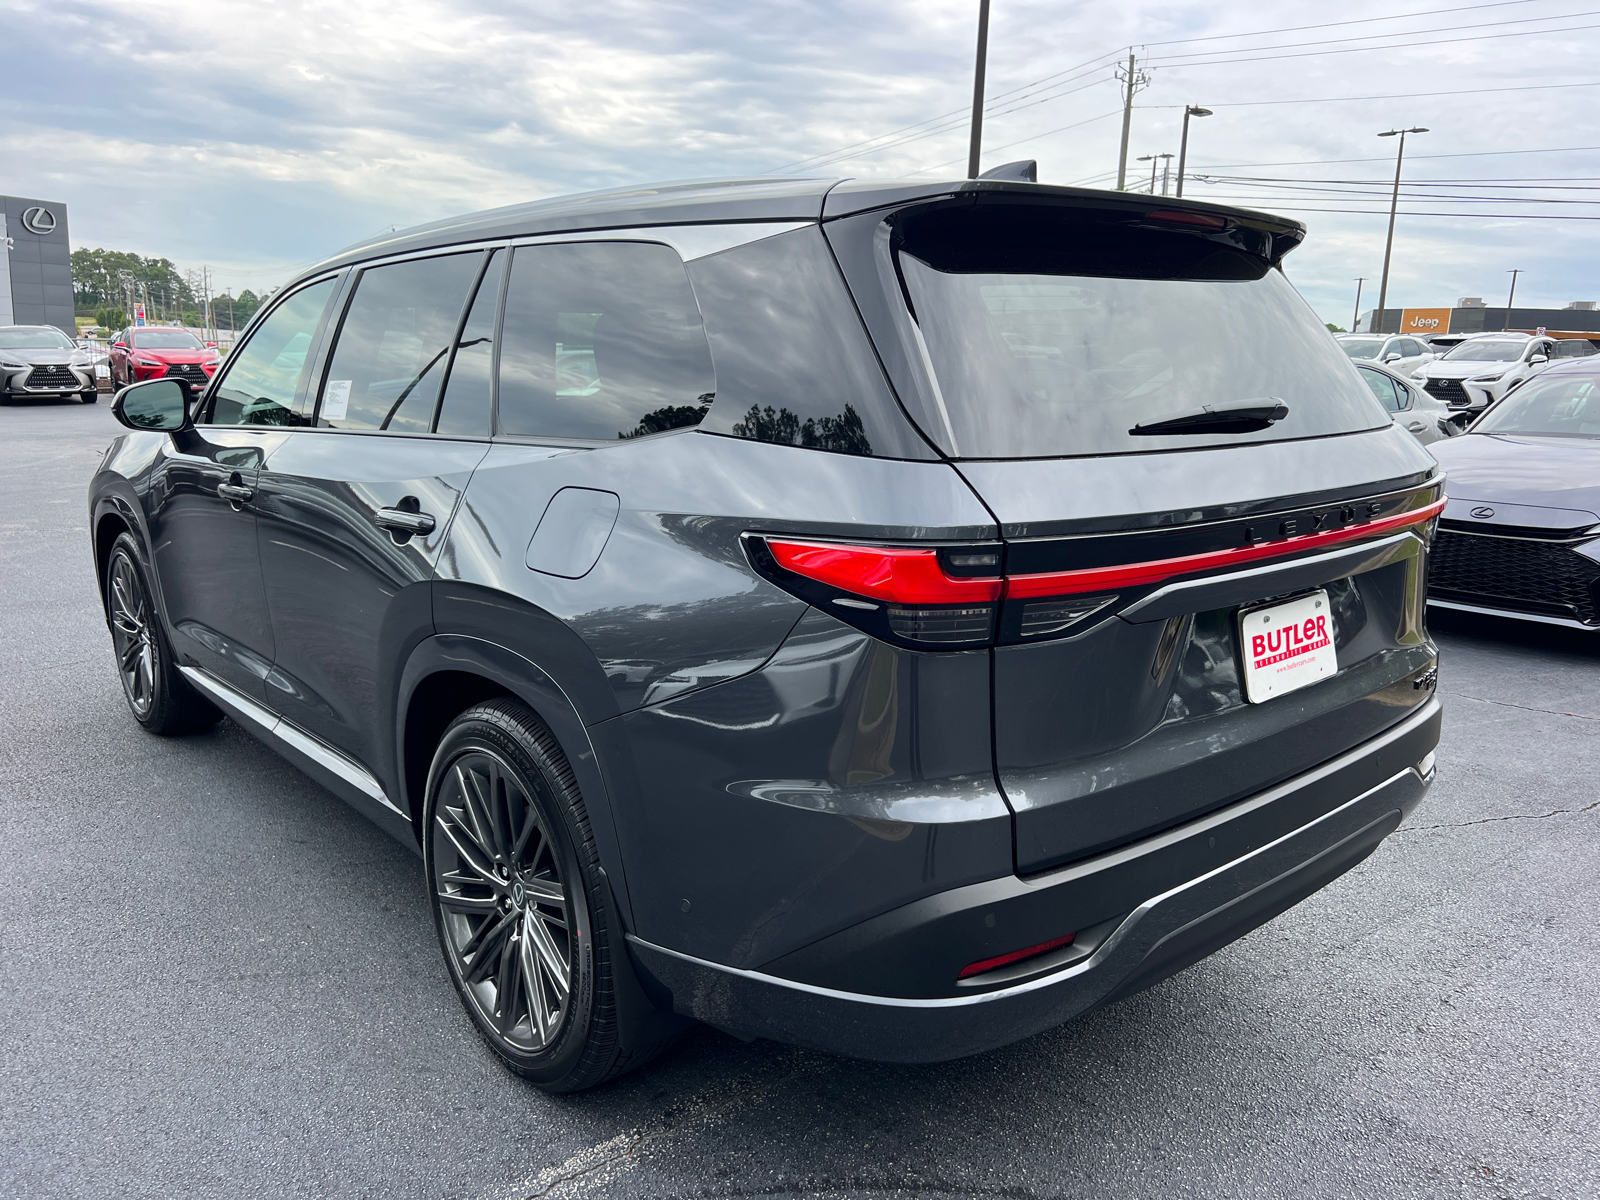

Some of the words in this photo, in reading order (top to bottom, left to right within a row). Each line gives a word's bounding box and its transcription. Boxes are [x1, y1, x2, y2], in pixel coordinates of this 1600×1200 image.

[1411, 315, 1440, 329] Jeep
[1244, 503, 1381, 543] LEXUS
[1254, 649, 1303, 669] AUTOMOTIVE
[1308, 637, 1330, 651] GROUP
[1276, 656, 1316, 674] www.butlercars.com
